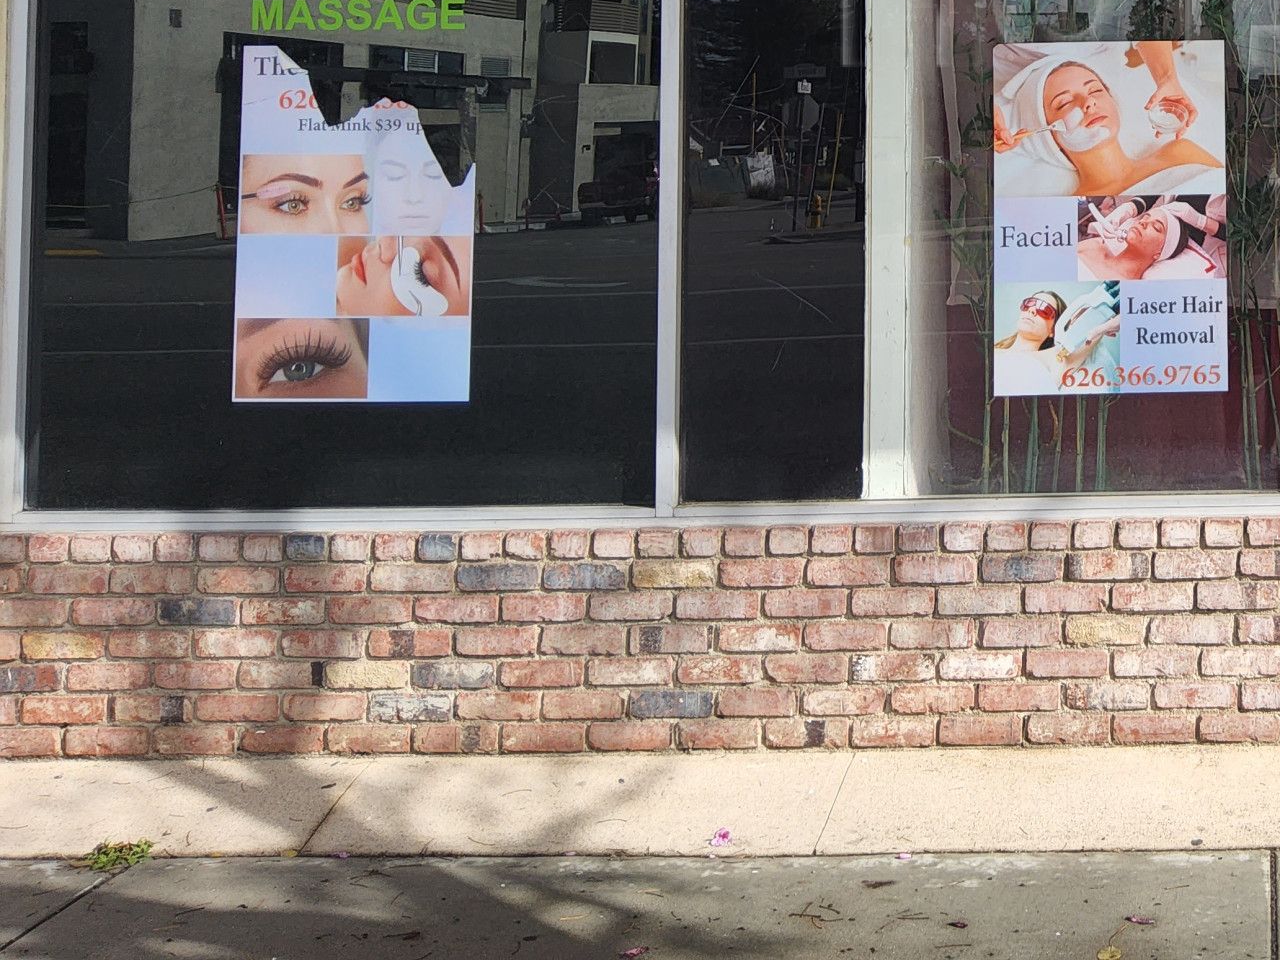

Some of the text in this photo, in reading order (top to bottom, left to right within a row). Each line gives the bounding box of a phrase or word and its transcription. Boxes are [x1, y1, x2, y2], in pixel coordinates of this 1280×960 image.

[298, 118, 326, 131] Flat
[375, 119, 402, 133] $39
[1000, 224, 1073, 248] Facial
[1127, 296, 1223, 315] Laser Hair
[1136, 326, 1215, 345] Removal
[1061, 365, 1222, 388] 626.366.9765
